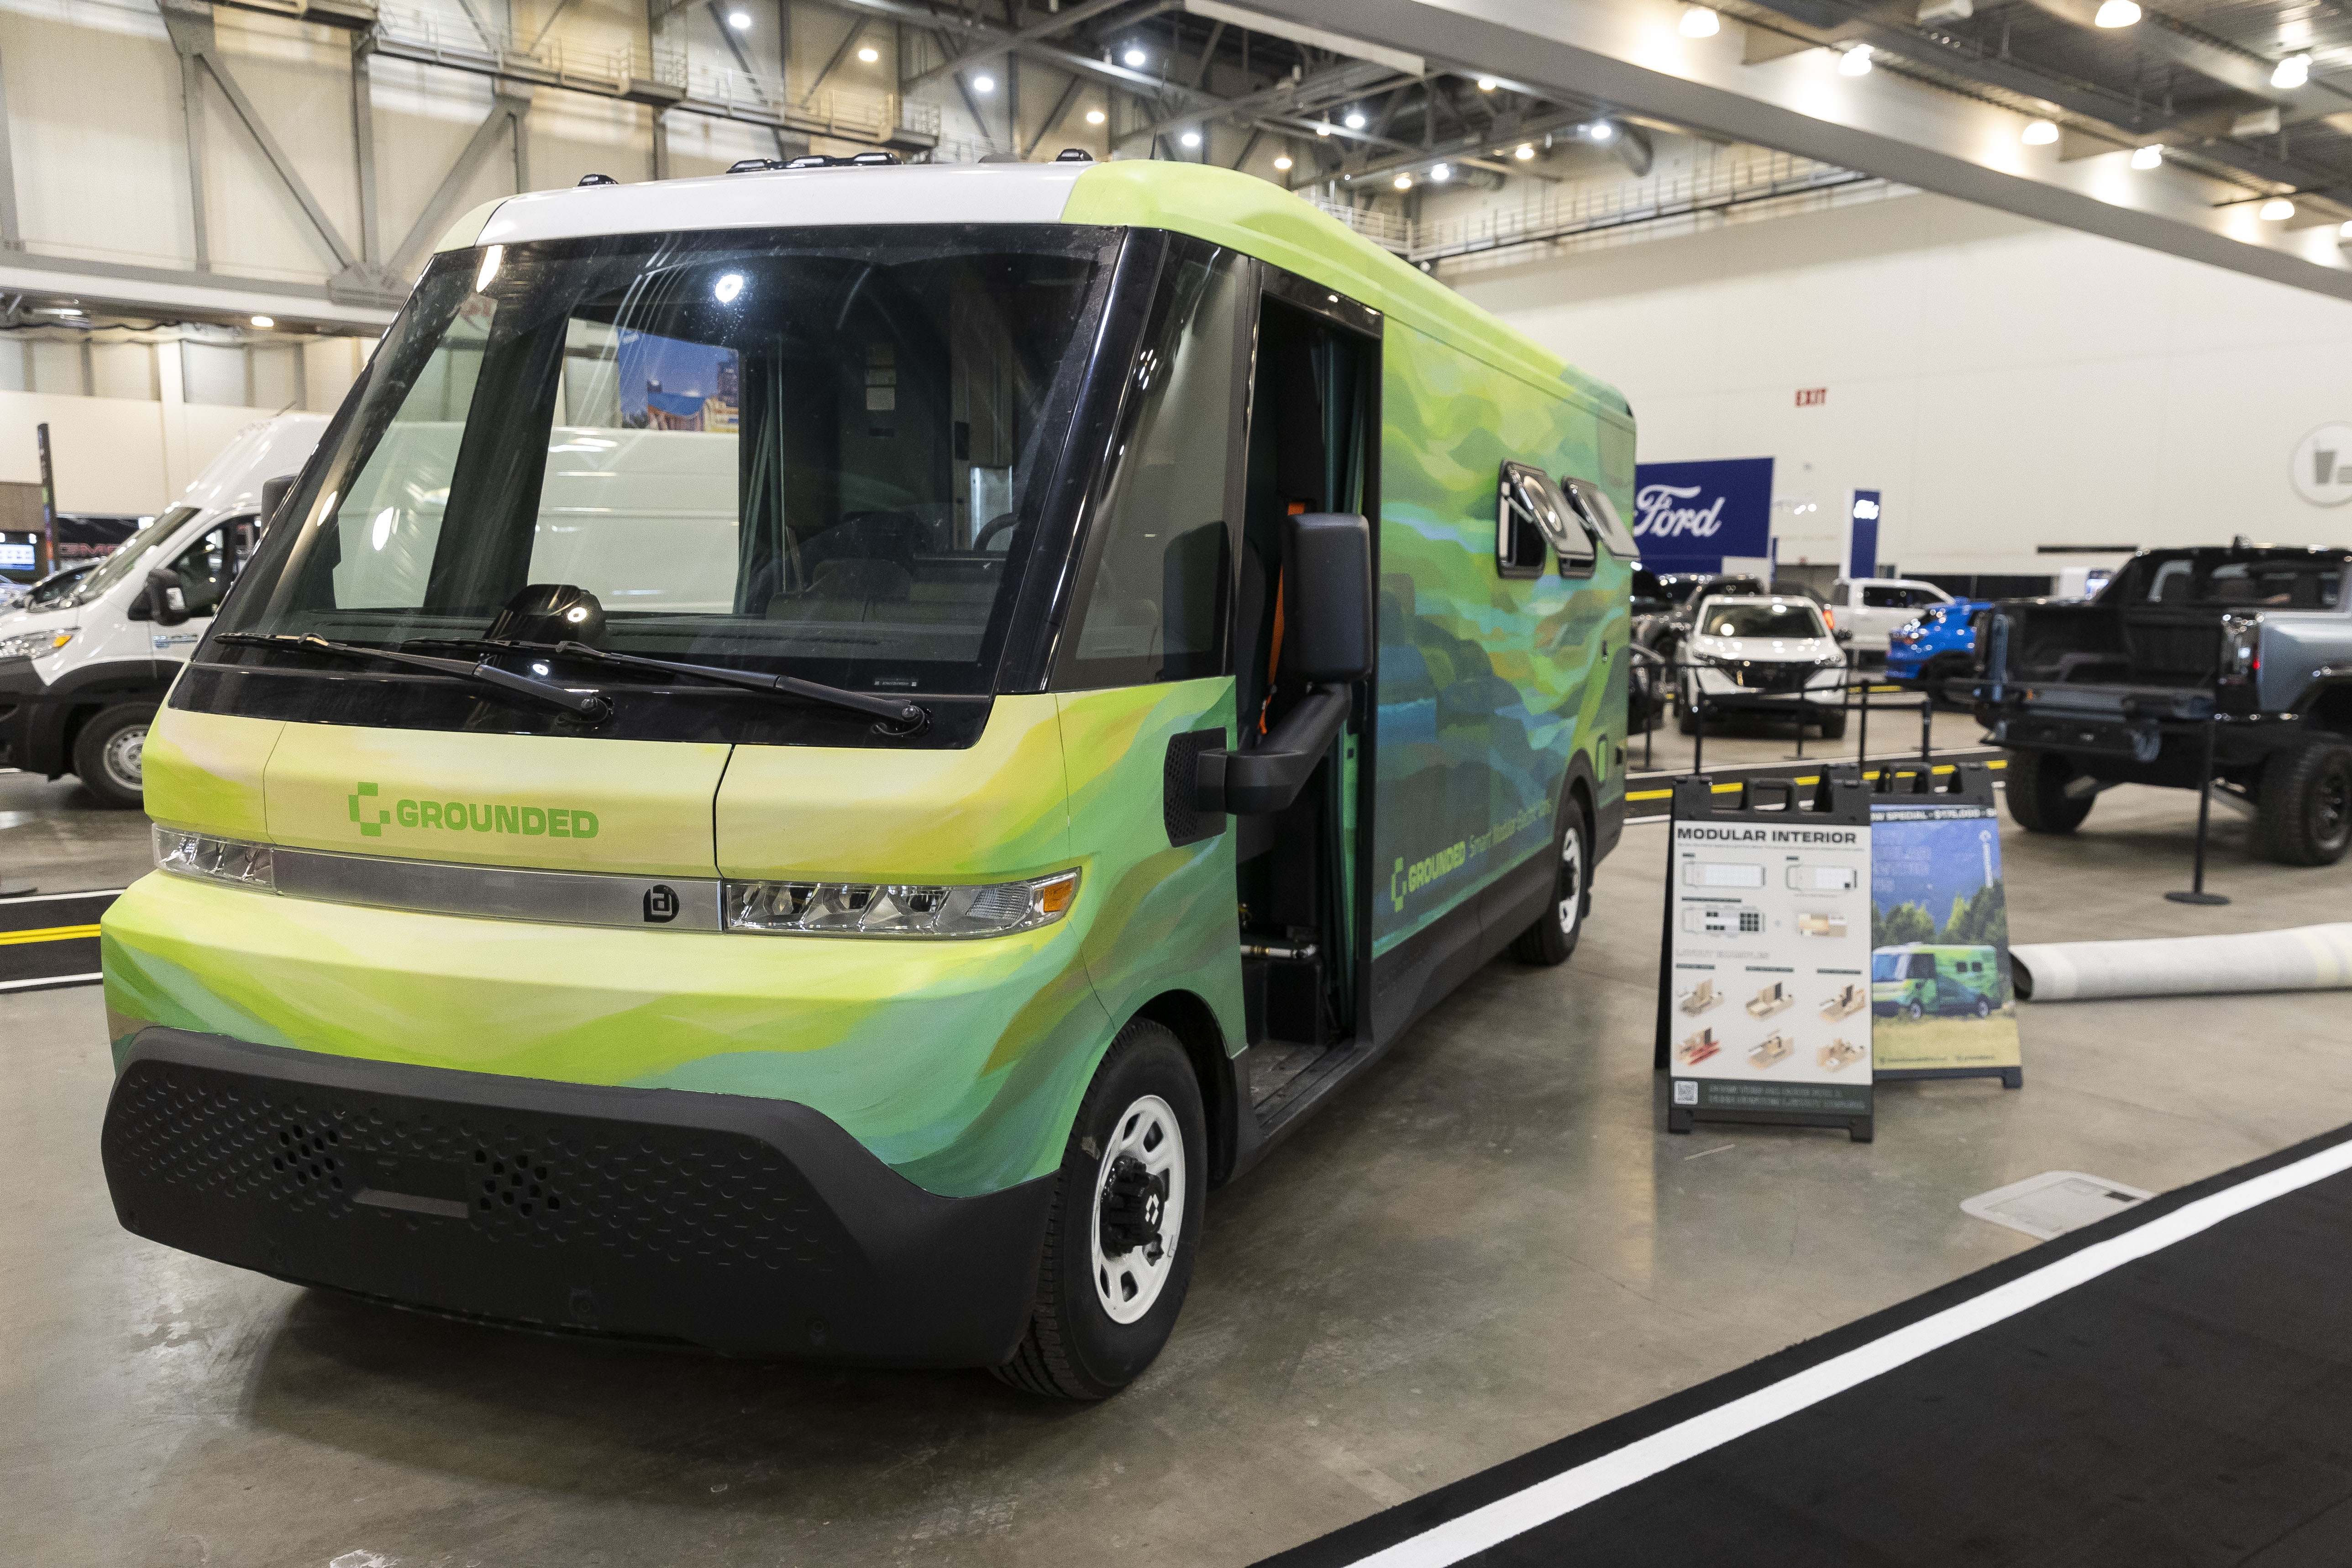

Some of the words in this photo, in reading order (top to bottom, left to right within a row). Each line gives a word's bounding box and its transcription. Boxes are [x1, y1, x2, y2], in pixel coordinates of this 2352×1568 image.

[1796, 388, 1827, 407] EXIT
[1633, 483, 1725, 538] Ford
[396, 799, 599, 839] GROUNDED
[1677, 828, 1767, 842] MODULAR
[1772, 831, 1857, 844] INTERIOR
[1408, 840, 1466, 893] GROUNDED
